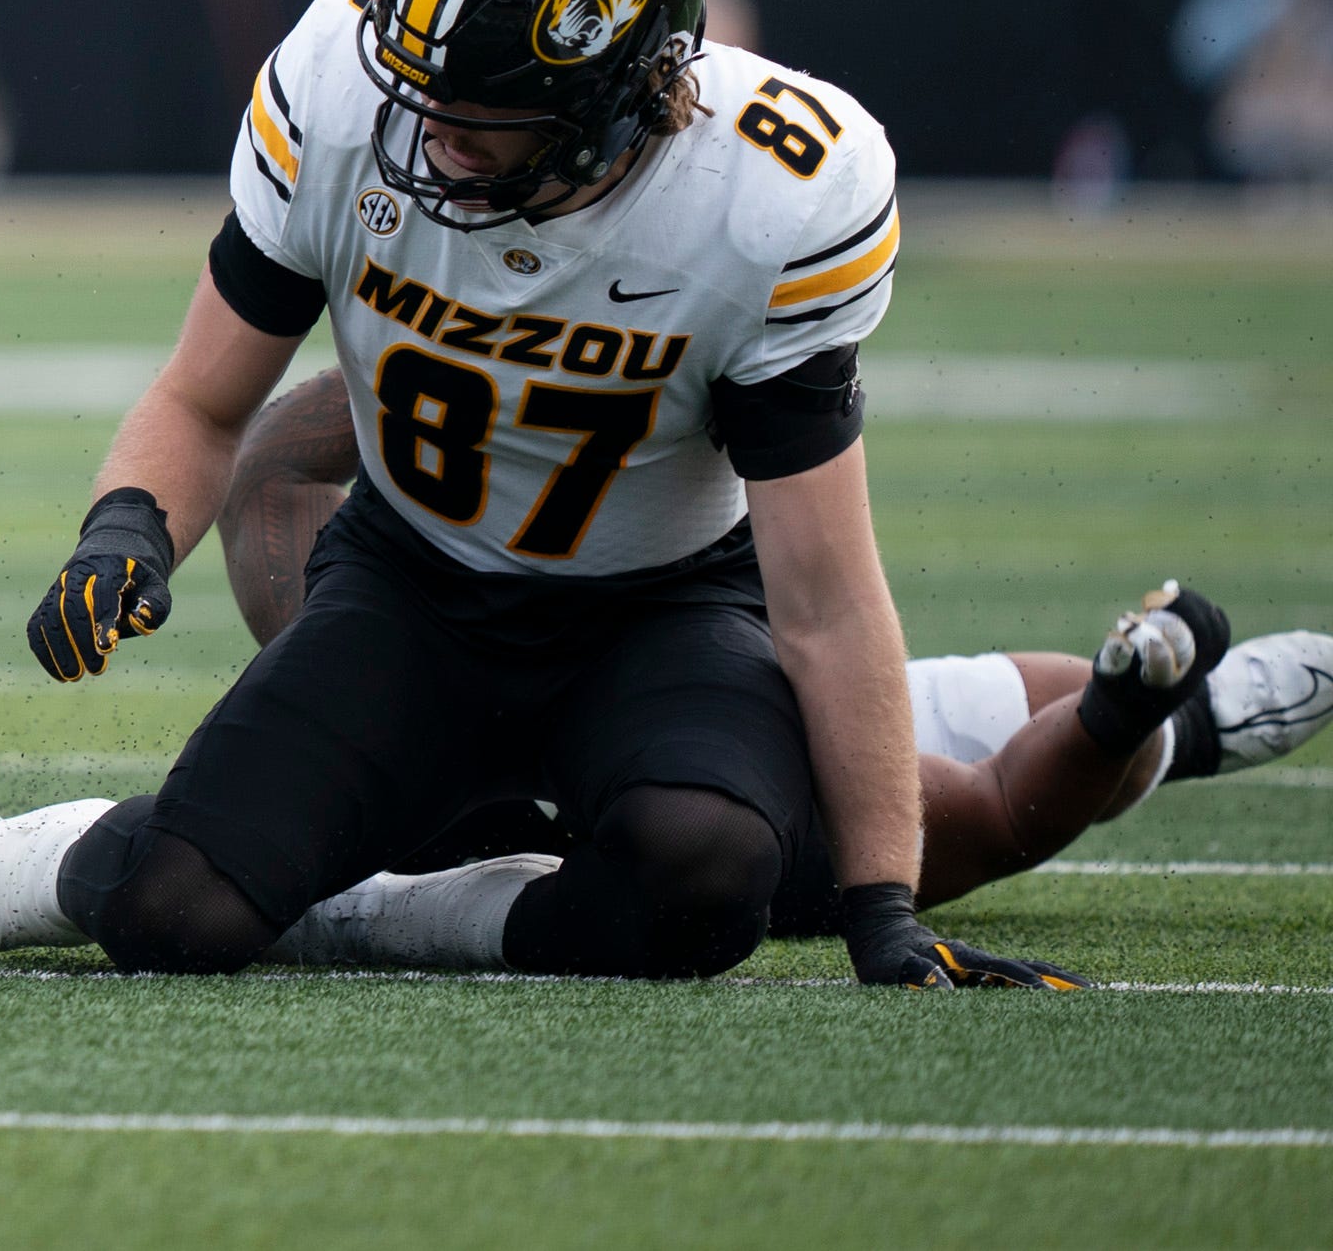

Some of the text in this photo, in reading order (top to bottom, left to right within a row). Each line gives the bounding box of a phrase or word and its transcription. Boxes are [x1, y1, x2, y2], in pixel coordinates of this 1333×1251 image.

[382, 48, 431, 86] MIZZOU
[734, 74, 845, 181] 87
[357, 192, 399, 234] SEC
[353, 256, 691, 382] MIZZOU
[373, 342, 664, 560] 87
